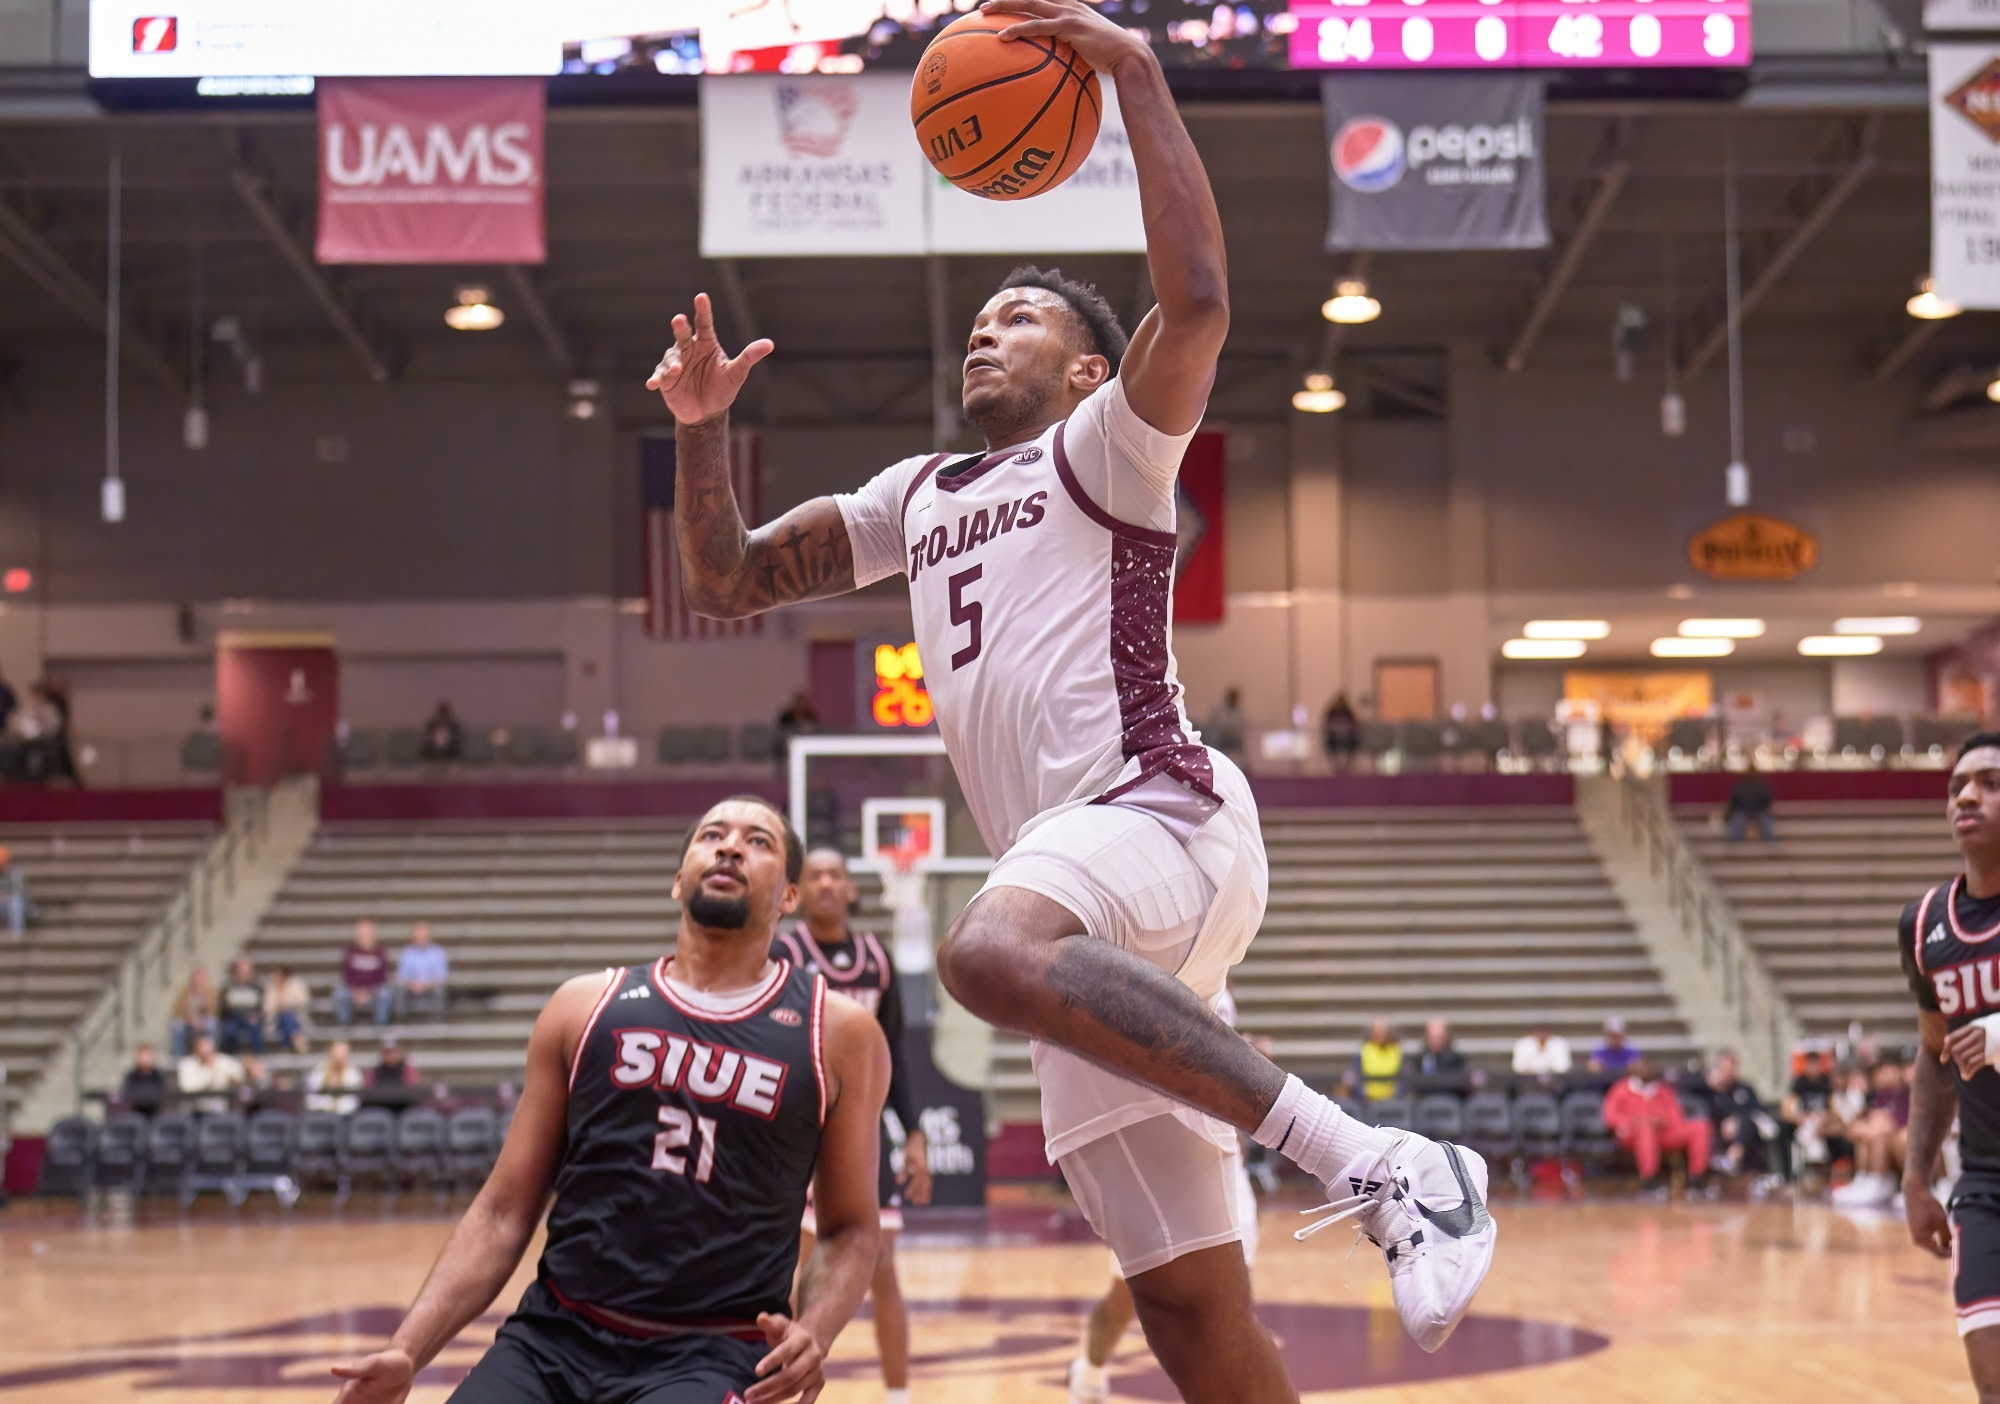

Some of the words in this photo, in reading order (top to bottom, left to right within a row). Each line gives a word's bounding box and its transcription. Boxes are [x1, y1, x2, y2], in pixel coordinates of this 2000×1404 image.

[1318, 16, 1374, 62] 24
[1402, 15, 1434, 61] 0
[1475, 15, 1507, 61] 0
[1548, 13, 1604, 58] 42
[1629, 13, 1661, 57] 0
[1703, 12, 1735, 57] 3
[327, 123, 533, 185] UAMS
[1407, 117, 1533, 169] pepsi
[740, 163, 893, 185] ARKANSAS
[751, 191, 878, 209] FEDERAL
[949, 563, 982, 671] 5
[612, 1029, 787, 1119] SIUE
[652, 1106, 717, 1182] 21
